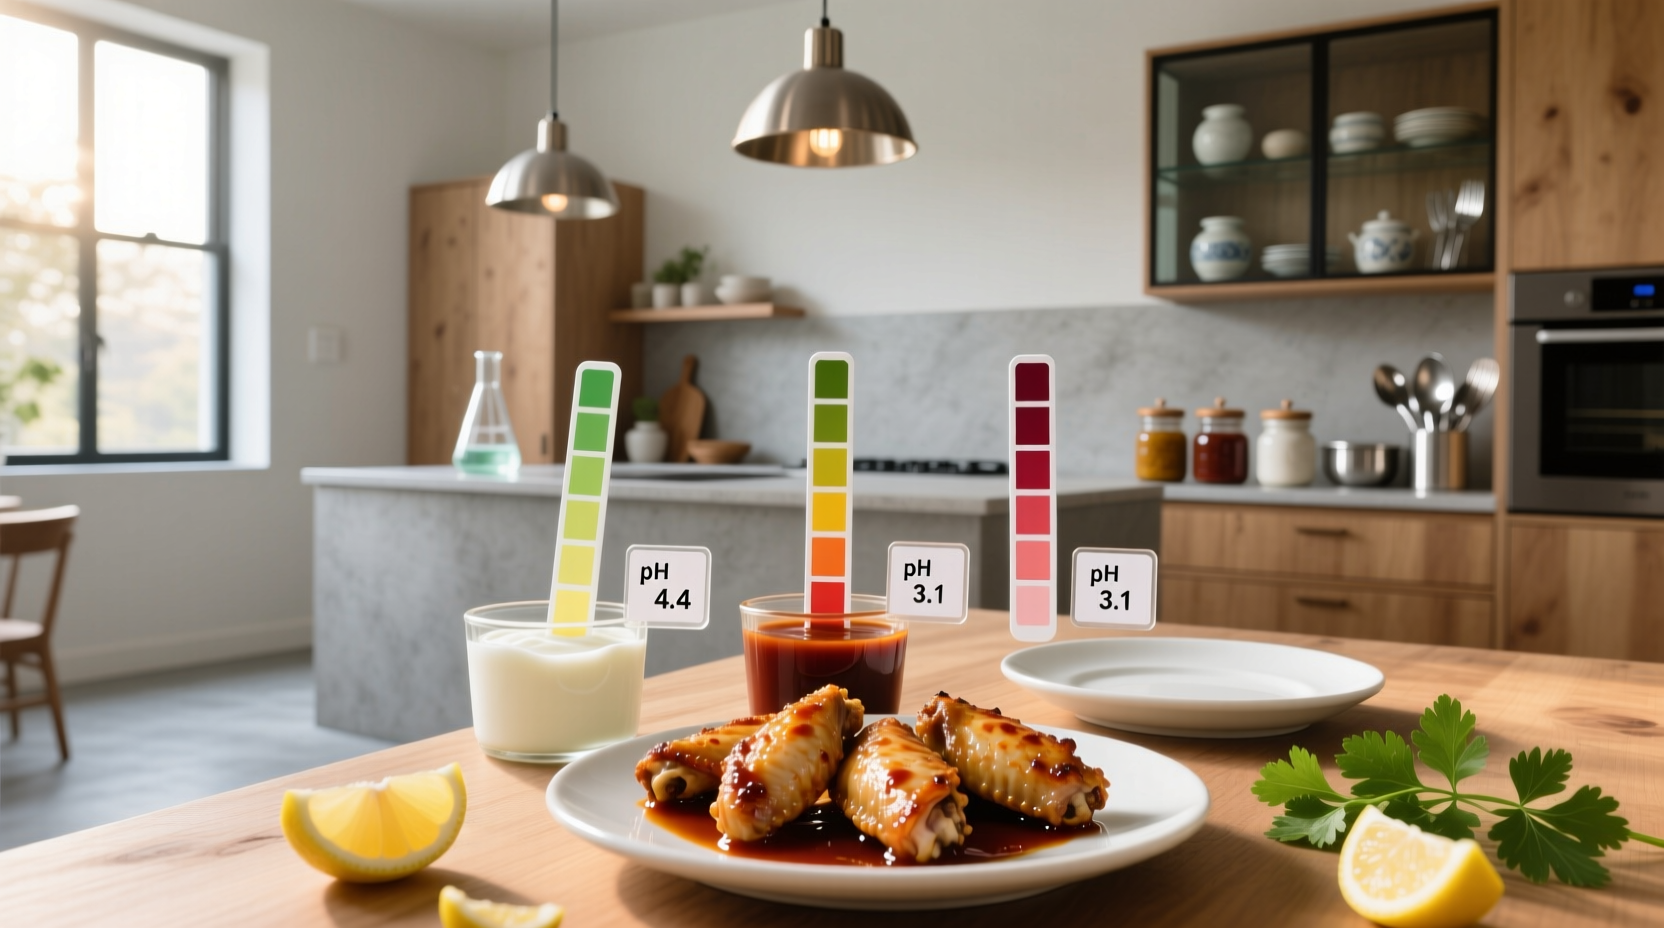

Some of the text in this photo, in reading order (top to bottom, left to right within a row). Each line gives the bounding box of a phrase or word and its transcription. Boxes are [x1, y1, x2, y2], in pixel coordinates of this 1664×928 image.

[640, 562, 669, 586] pH
[903, 559, 931, 581] pH
[1090, 564, 1119, 587] pH
[653, 588, 693, 610] 4.4
[913, 583, 943, 604] 3.1
[1099, 589, 1130, 611] 3.1
